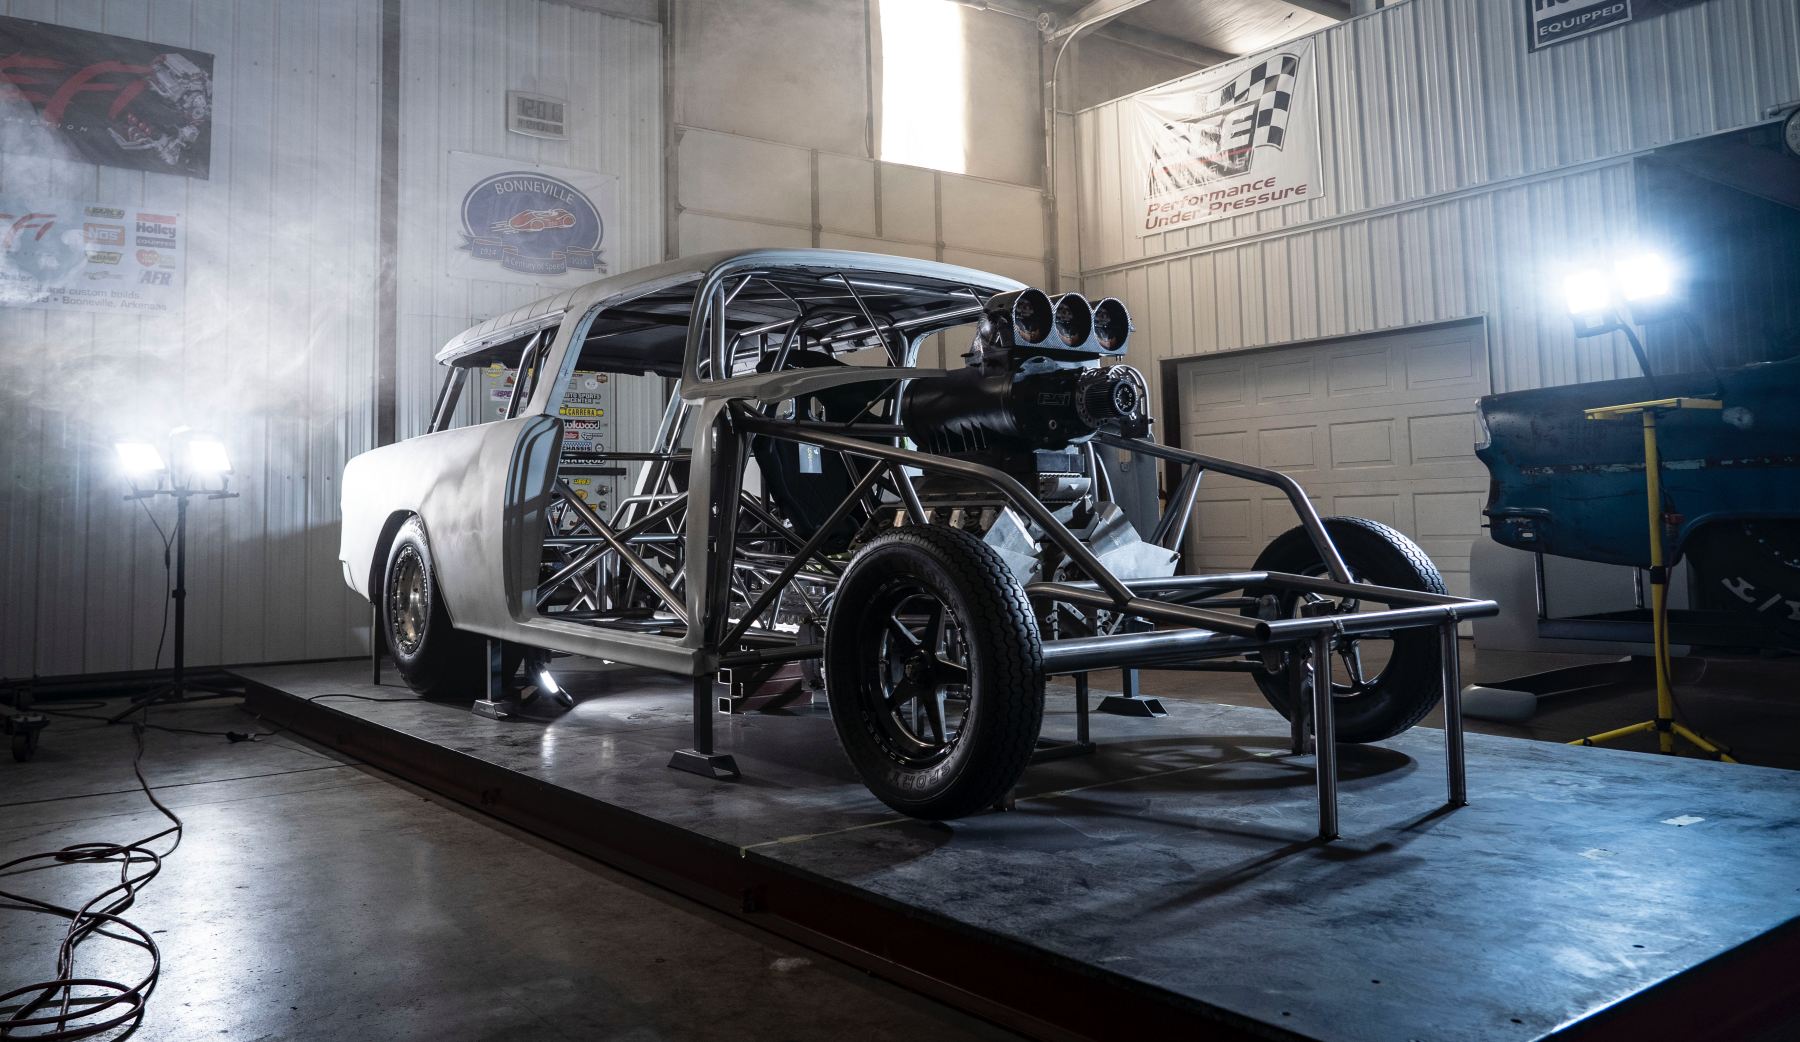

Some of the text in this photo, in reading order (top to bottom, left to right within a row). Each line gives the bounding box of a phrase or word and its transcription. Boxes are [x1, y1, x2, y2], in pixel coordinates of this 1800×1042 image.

[1539, 4, 1625, 36] EQUIPPED
[494, 180, 575, 205] BONNEVILLE
[1147, 176, 1276, 216] Performance
[1145, 184, 1307, 230] Under Pressure
[136, 222, 176, 238] Holley
[69, 287, 107, 297] custom
[567, 408, 595, 416] CARRERA
